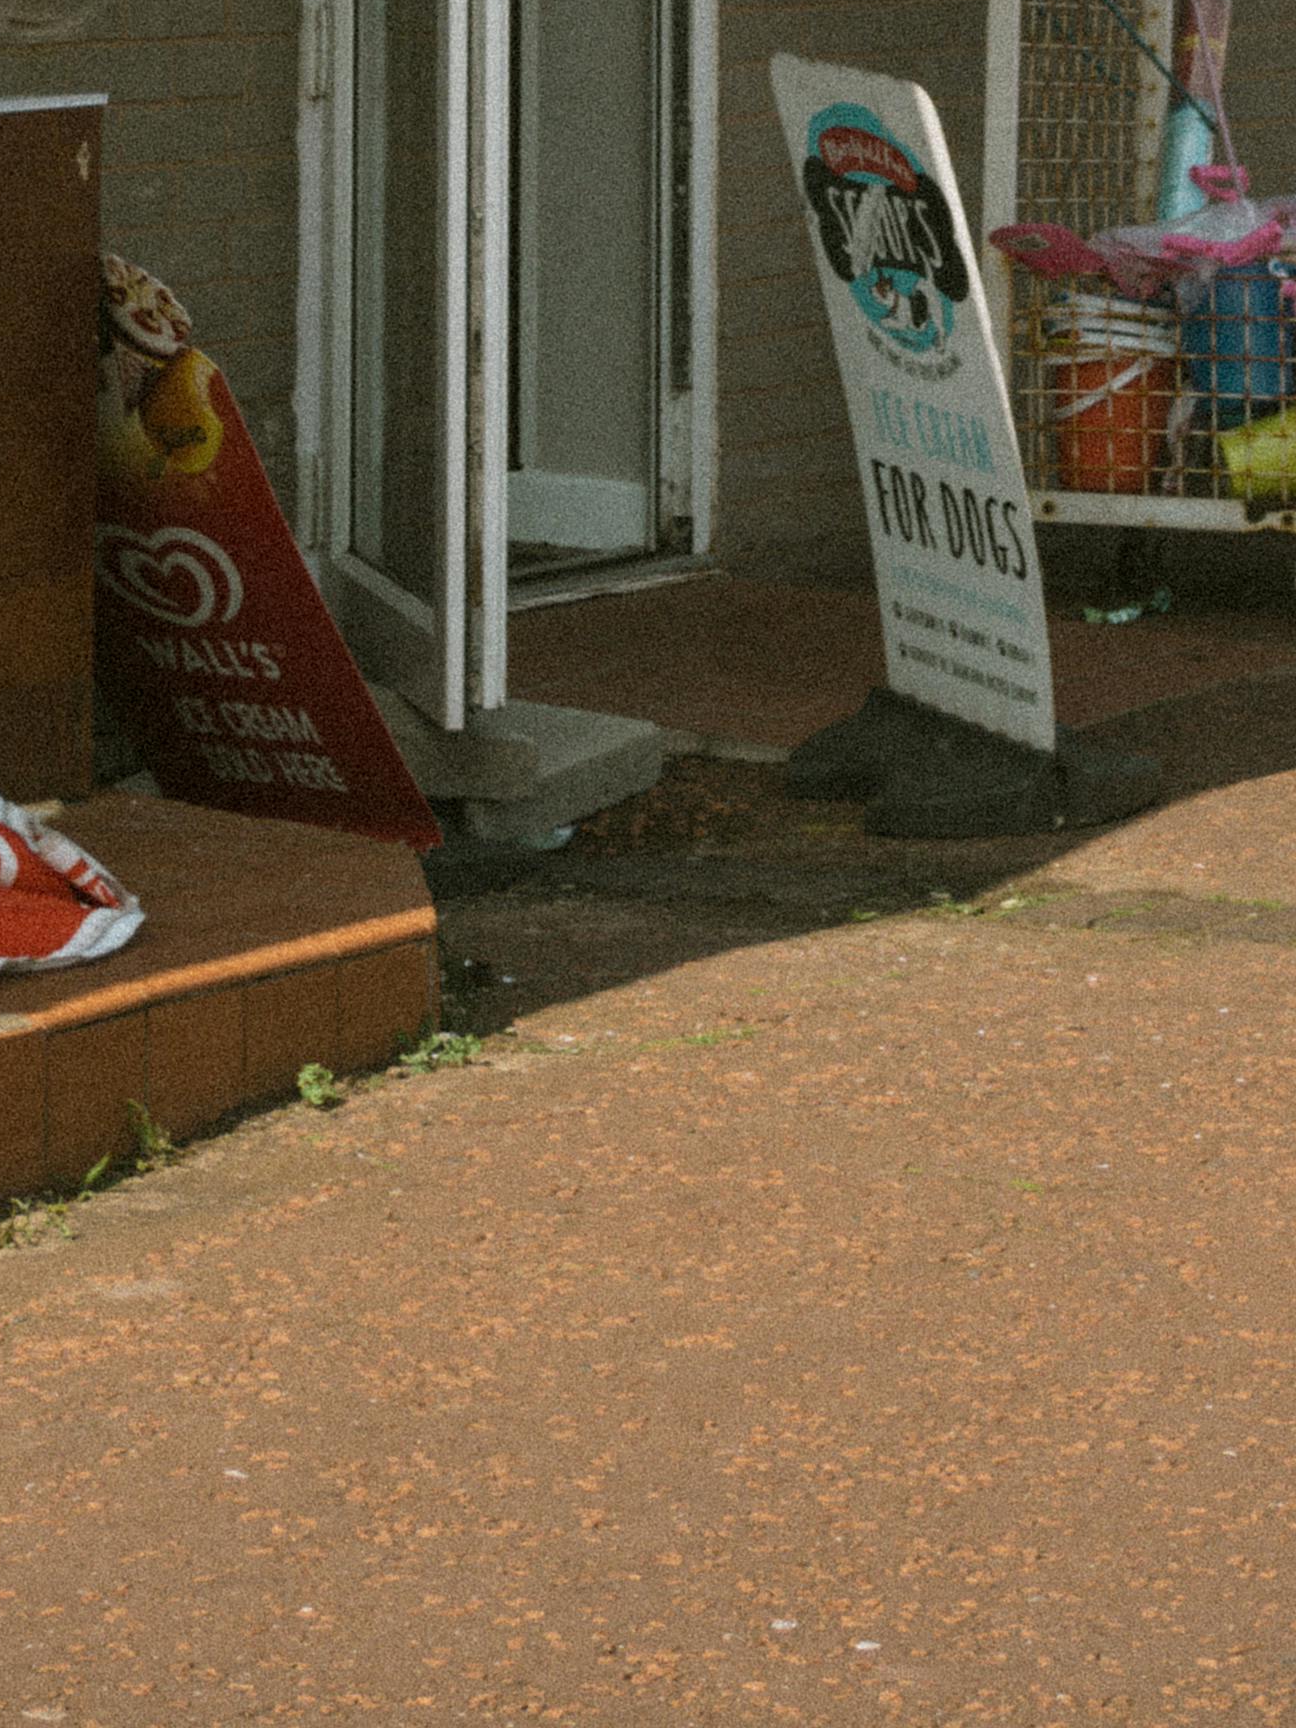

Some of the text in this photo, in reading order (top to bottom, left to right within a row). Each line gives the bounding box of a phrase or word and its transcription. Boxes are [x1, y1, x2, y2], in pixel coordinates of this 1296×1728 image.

[870, 457, 1028, 583] FOR DOGS
[135, 635, 281, 681] WALL'S
[217, 700, 323, 745] CREAM
[274, 751, 349, 794] HERE
